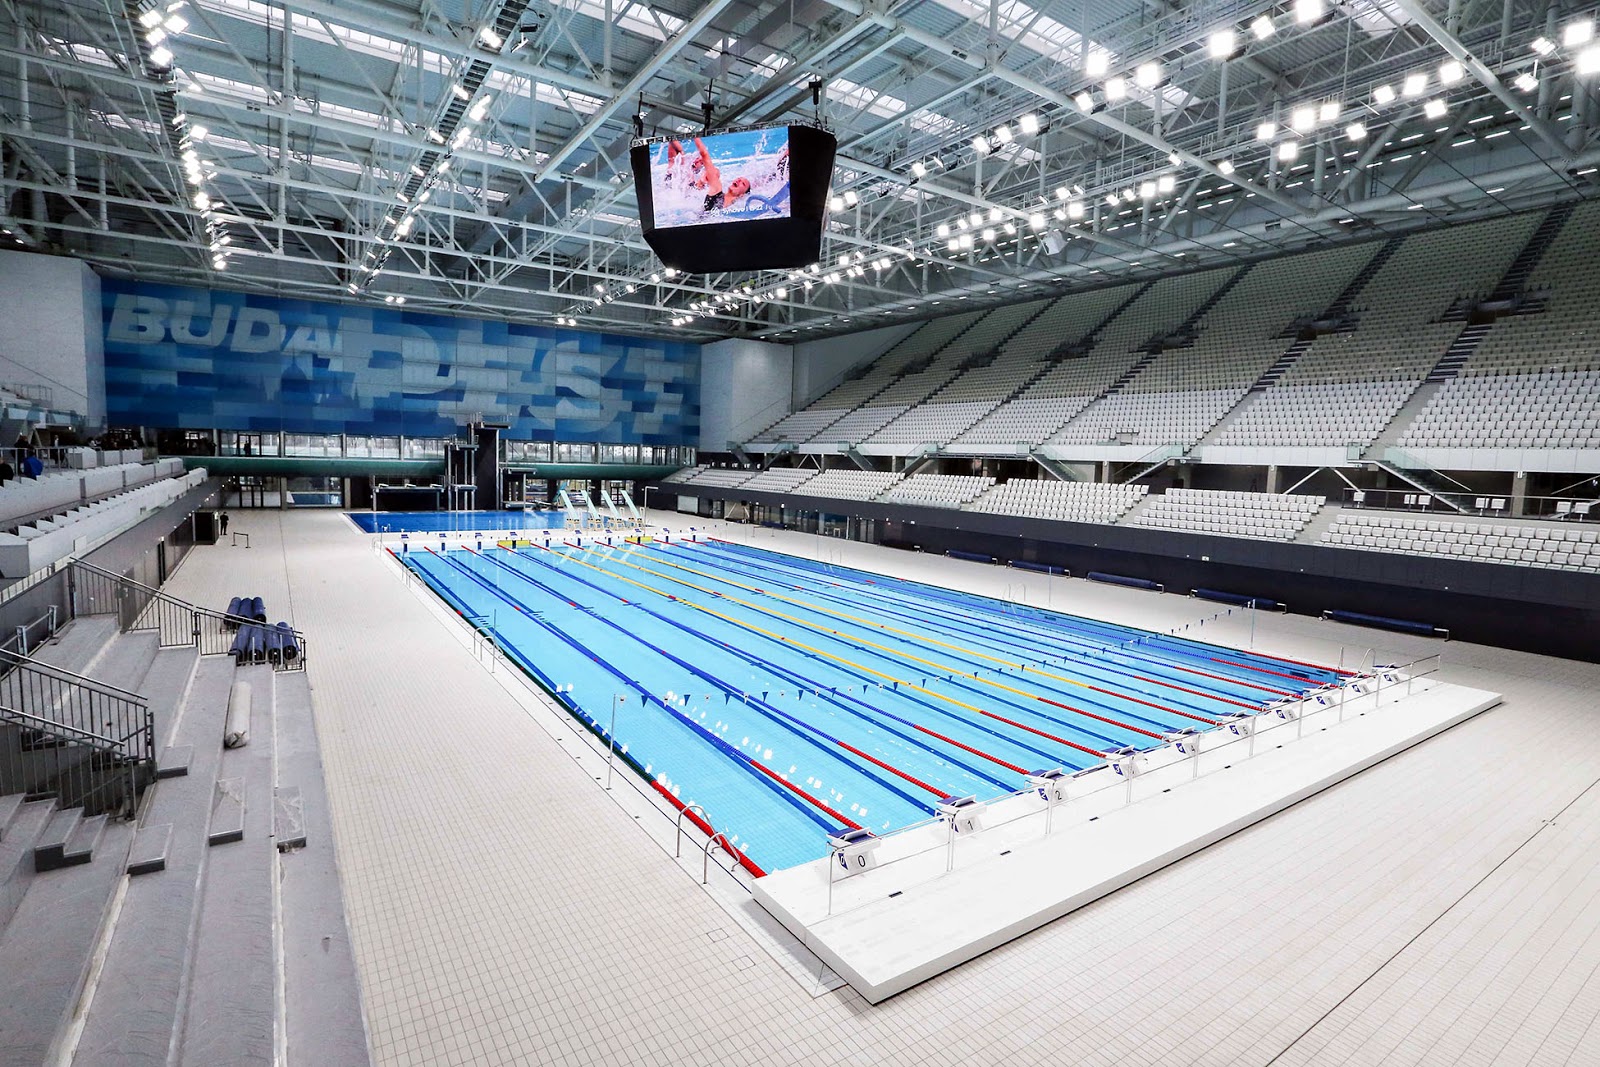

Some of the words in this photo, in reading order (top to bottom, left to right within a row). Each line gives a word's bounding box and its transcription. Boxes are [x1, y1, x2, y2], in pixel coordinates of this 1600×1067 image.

[105, 293, 690, 435] BUDAPEST
[1055, 790, 1063, 801] 2
[967, 820, 974, 831] 1
[857, 854, 866, 868] 0
